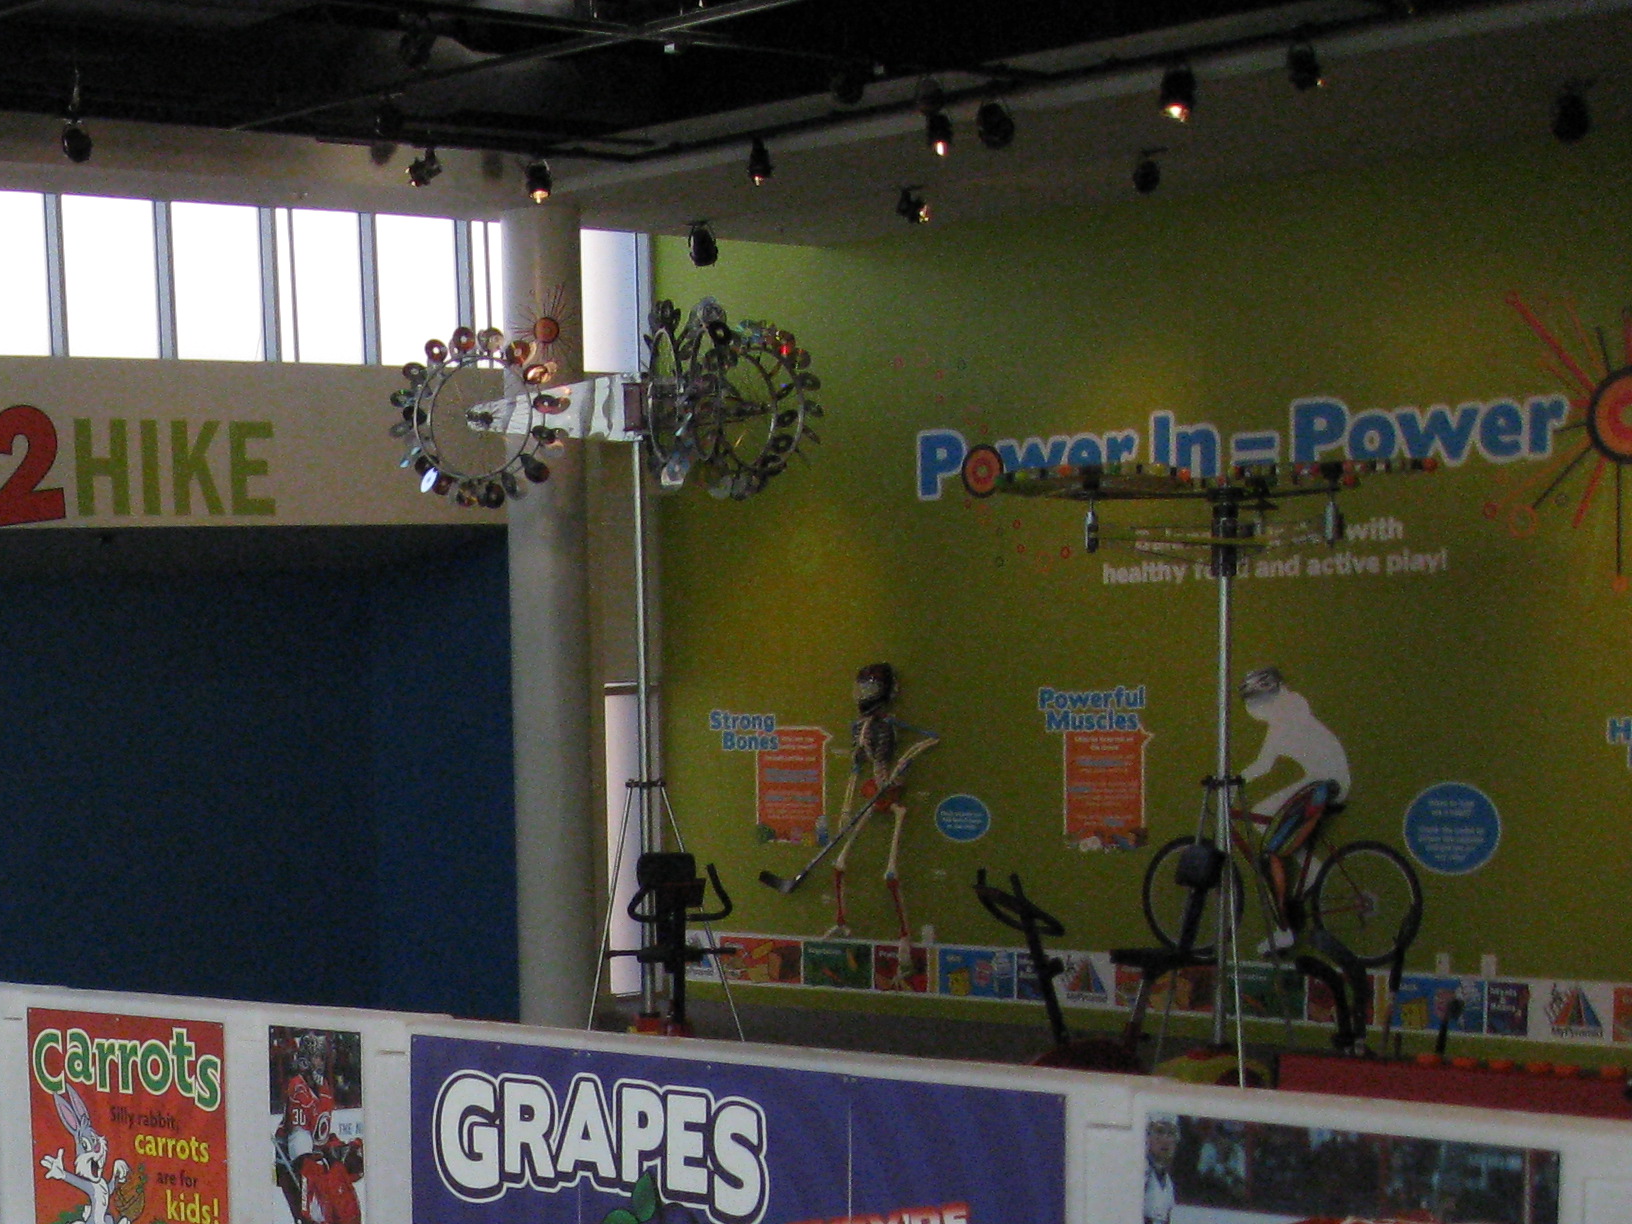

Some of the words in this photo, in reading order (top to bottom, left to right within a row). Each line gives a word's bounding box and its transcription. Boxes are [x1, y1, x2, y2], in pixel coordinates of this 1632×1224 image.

[1289, 395, 1570, 468] Power
[1345, 516, 1405, 543] with
[1102, 560, 1188, 585] healthy
[1254, 554, 1302, 579] and
[1306, 551, 1381, 577] active
[1386, 547, 1449, 576] play!
[1038, 684, 1146, 711] Powerful
[709, 709, 777, 733] Strong
[1045, 707, 1140, 733] Muscles
[721, 730, 780, 751] Bones
[109, 1106, 136, 1130] Silly
[134, 1133, 211, 1164] carrots
[156, 1171, 177, 1187] are
[179, 1169, 199, 1188] for
